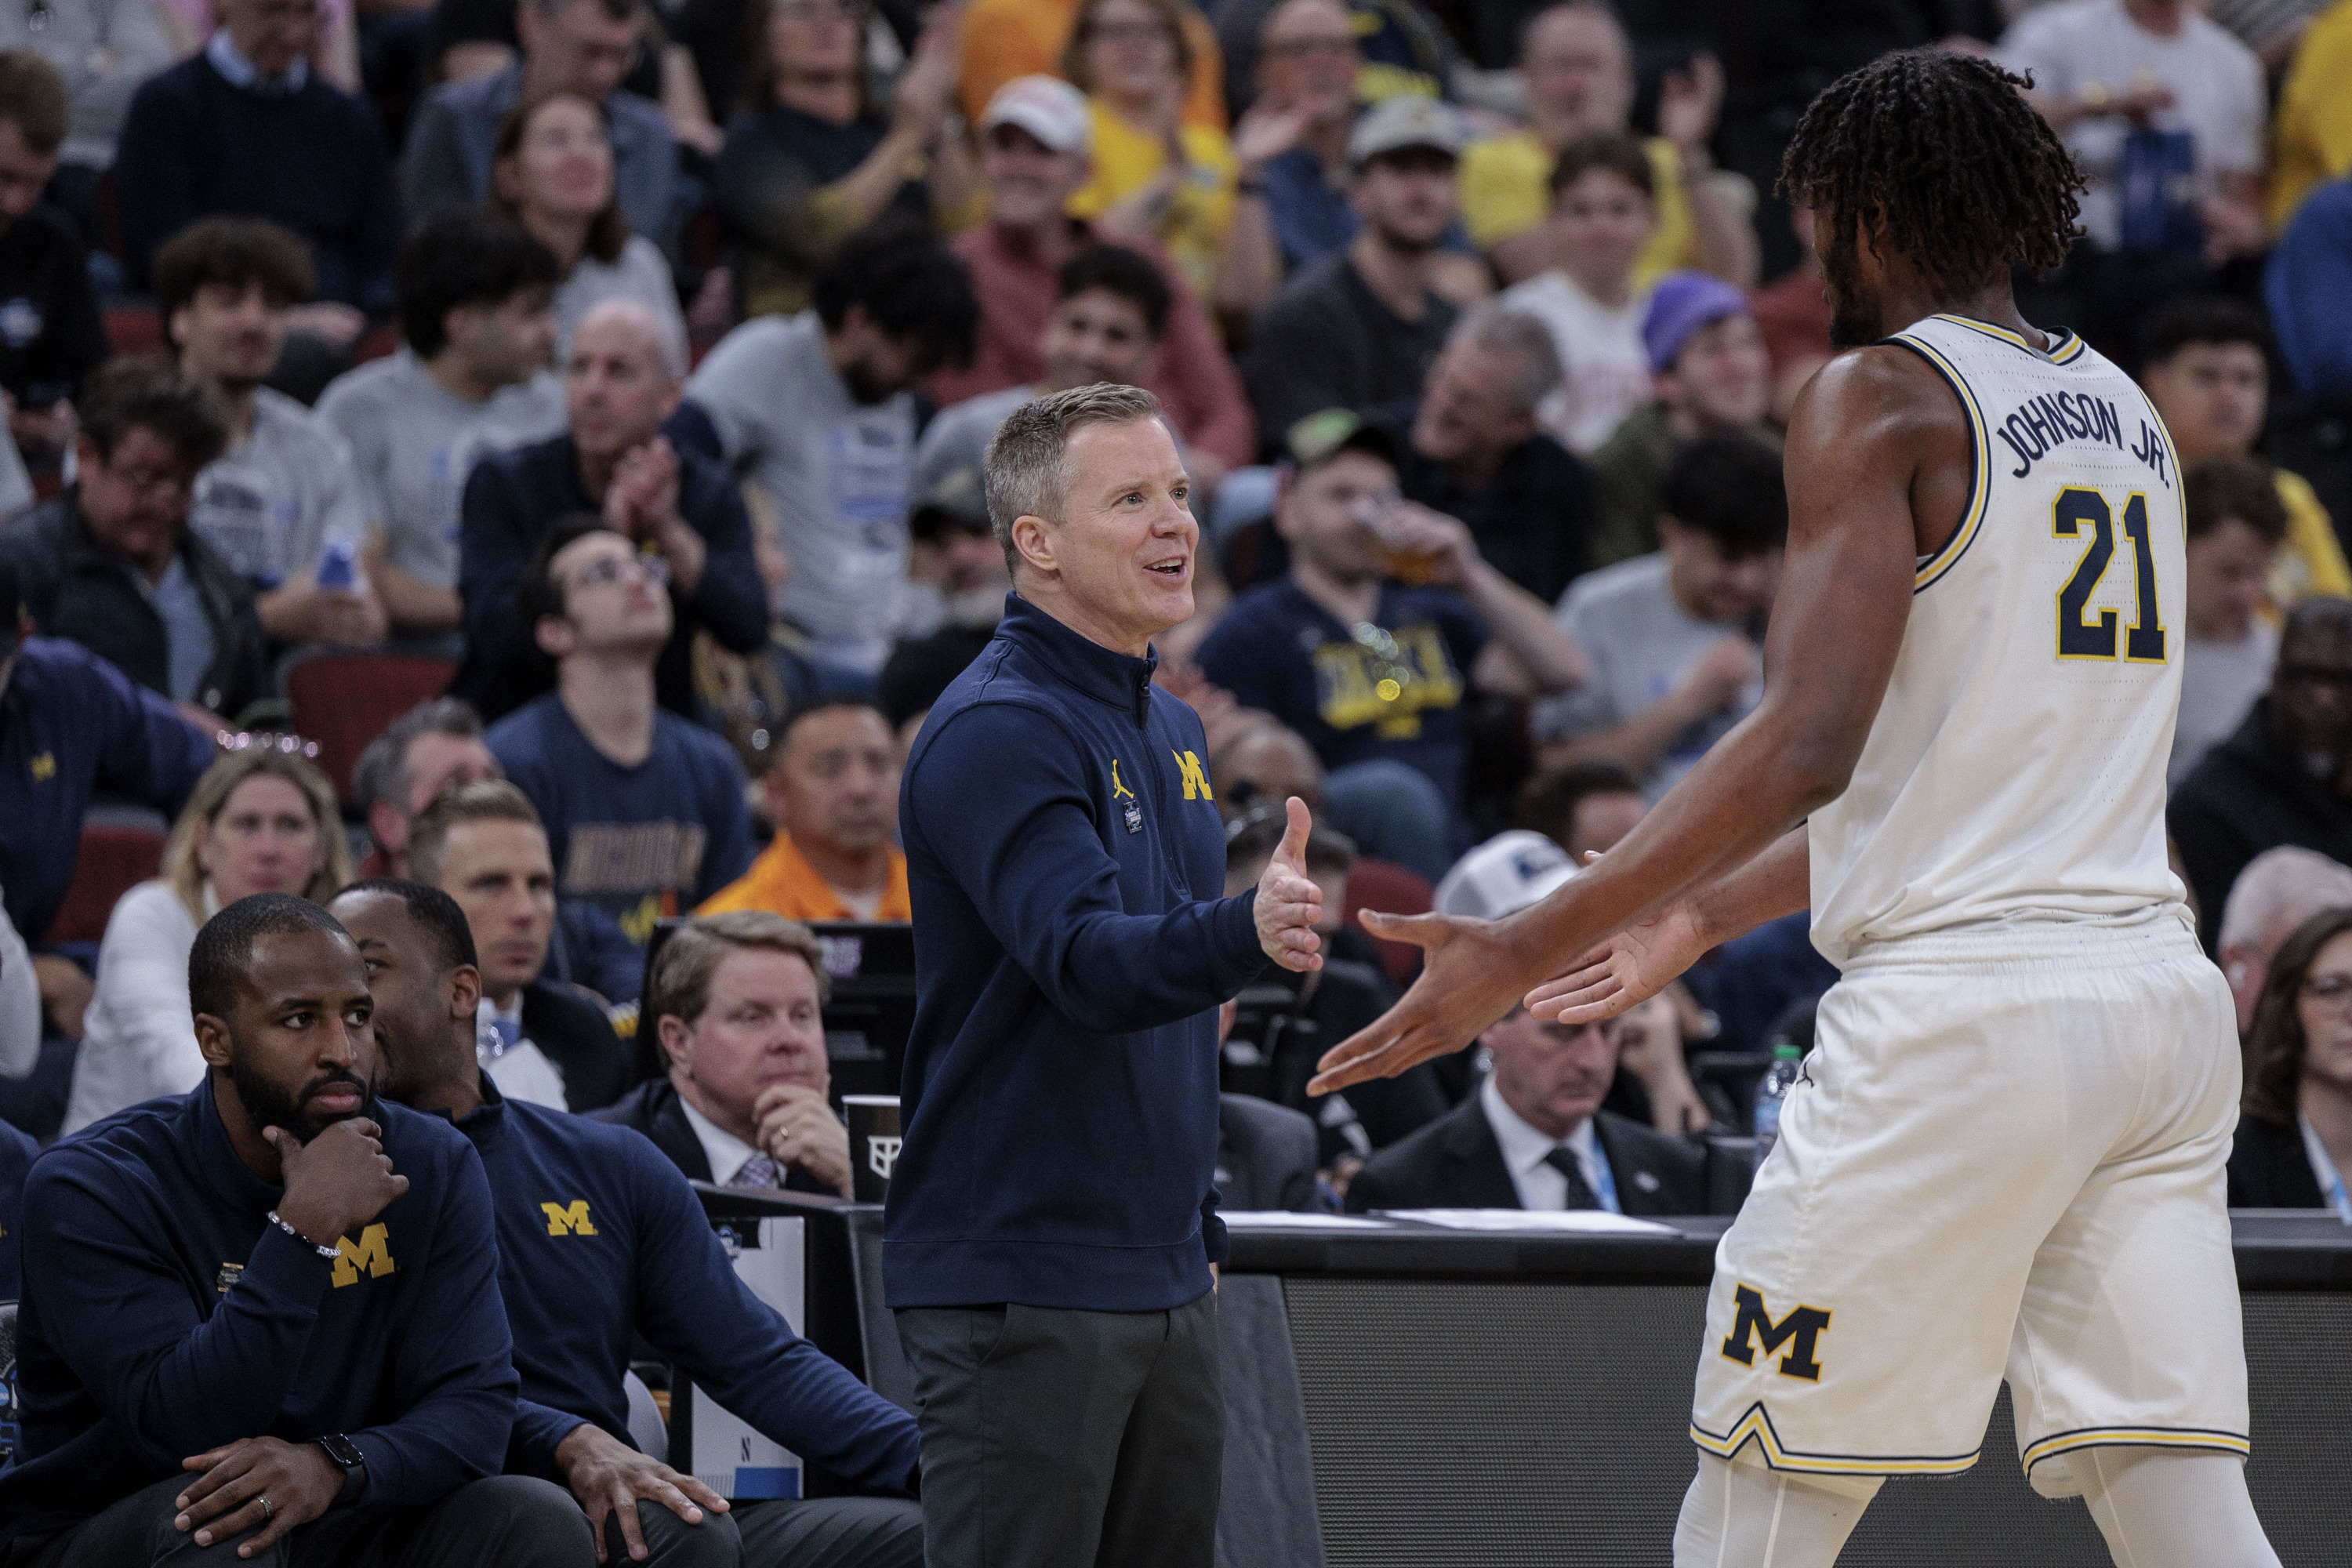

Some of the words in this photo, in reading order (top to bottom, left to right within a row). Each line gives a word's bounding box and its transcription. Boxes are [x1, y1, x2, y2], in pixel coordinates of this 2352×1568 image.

[1996, 390, 2124, 479] JOHNSON
[2131, 418, 2170, 490] JR.
[2051, 484, 2168, 665] 21
[1171, 749, 1214, 800] M
[330, 1221, 395, 1289] M
[540, 1199, 594, 1236] M
[1719, 1281, 1834, 1385] M
